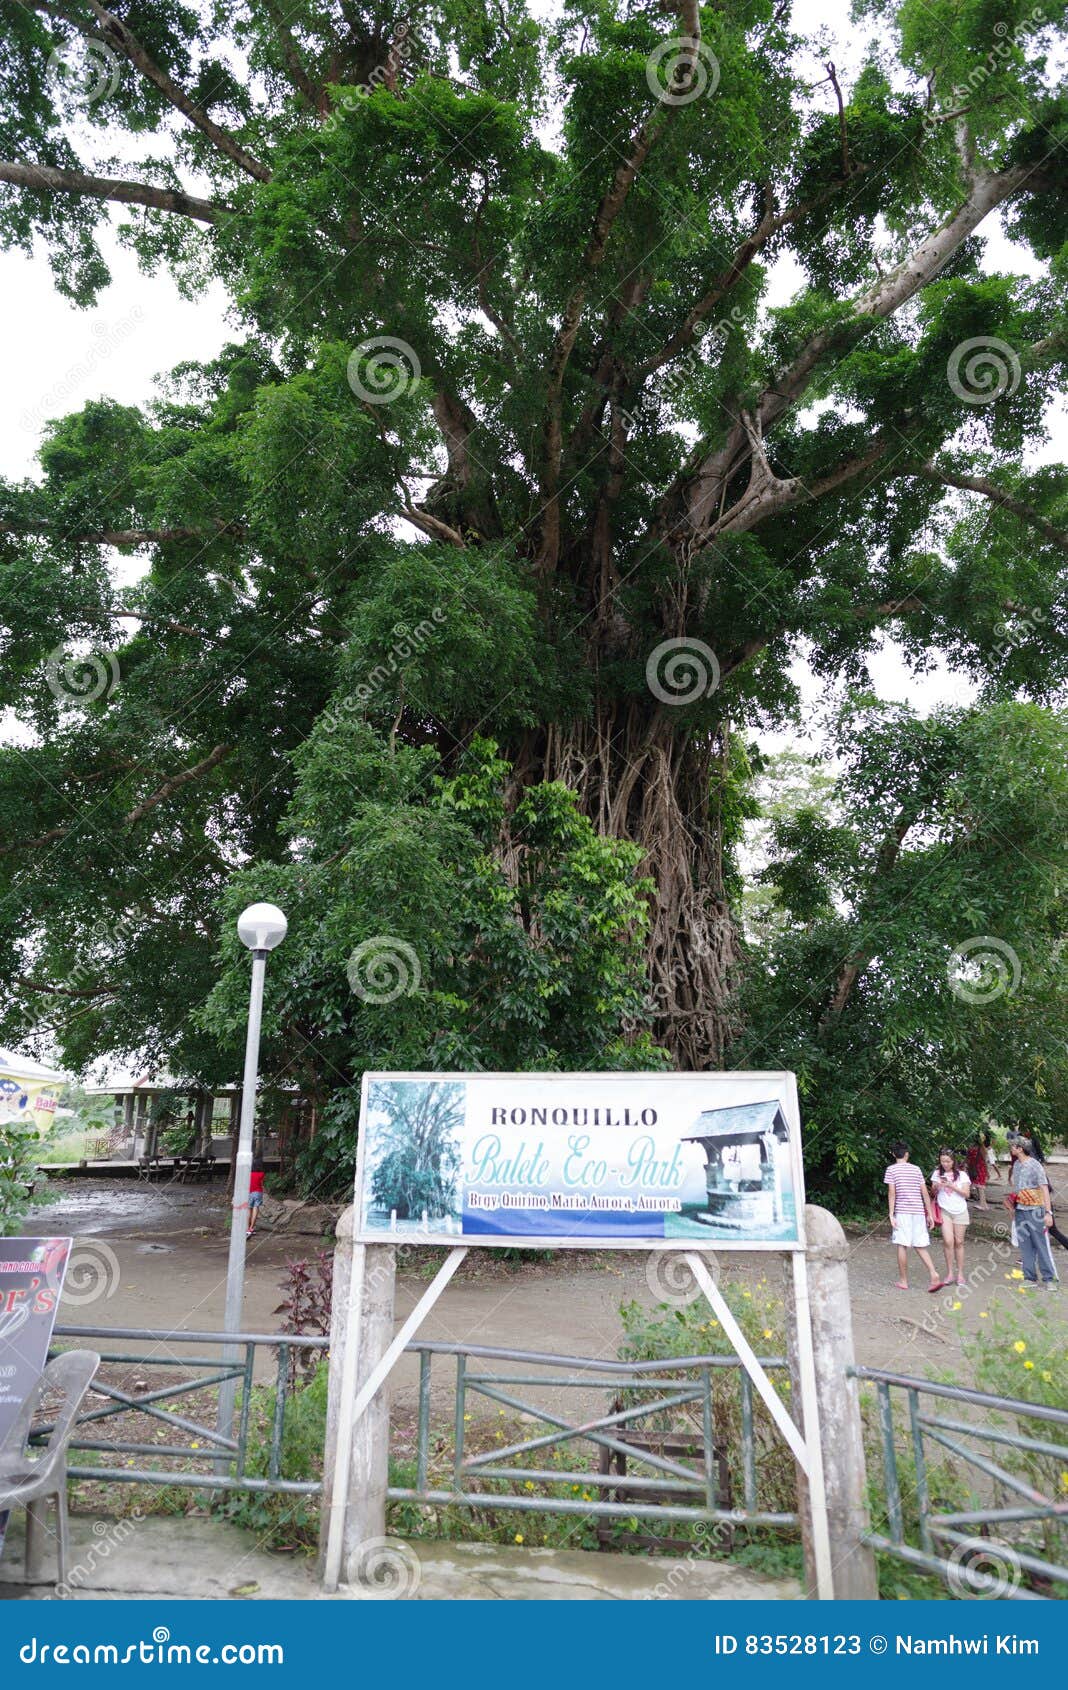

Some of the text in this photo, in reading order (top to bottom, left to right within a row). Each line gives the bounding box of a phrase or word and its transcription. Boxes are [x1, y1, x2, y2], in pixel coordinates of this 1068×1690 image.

[491, 1107, 658, 1127] RONQUILLO
[465, 1133, 551, 1185] Balete
[502, 1193, 549, 1209] Quirino,
[552, 1195, 586, 1209] Maria
[590, 1195, 634, 1210] Aurora,
[638, 1197, 680, 1210] Aurora
[0, 1277, 57, 1313] r's
